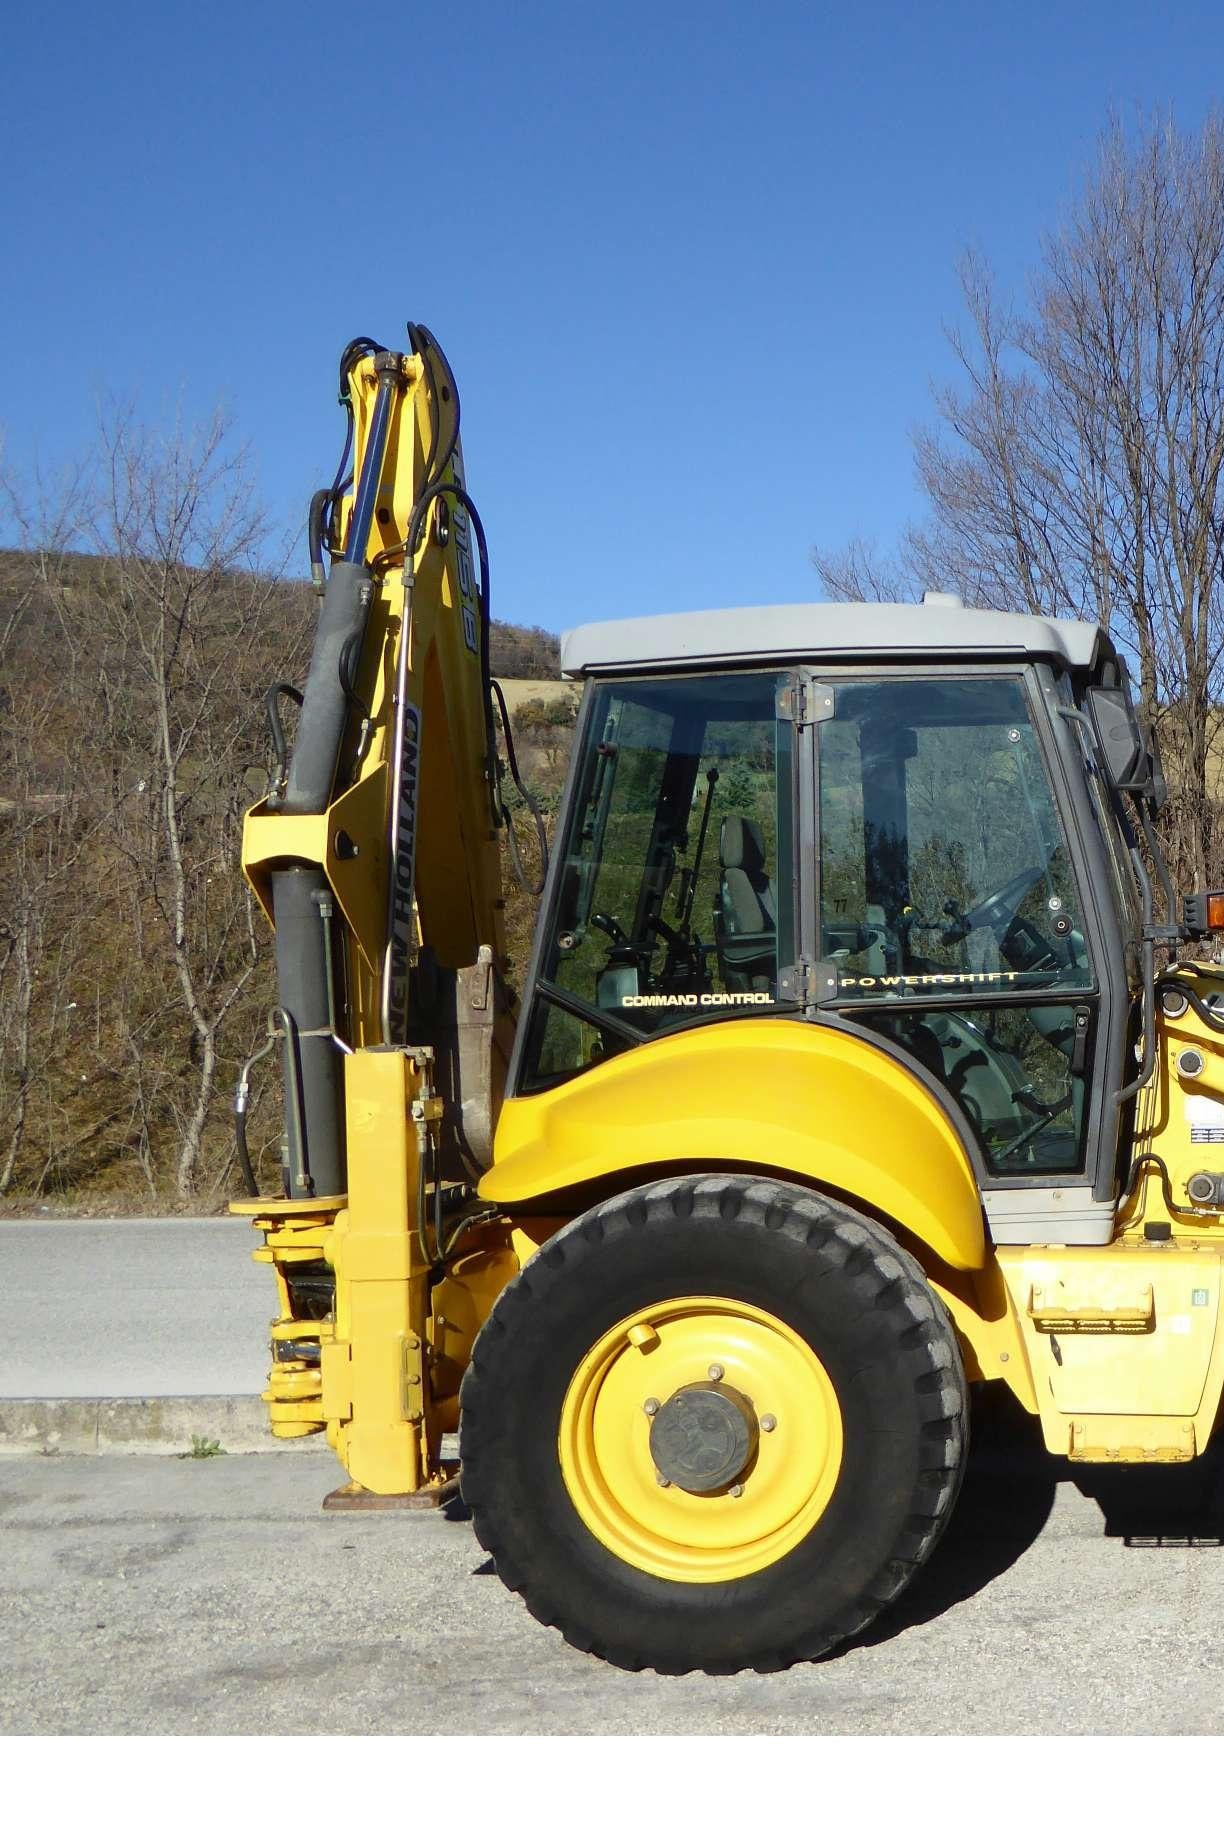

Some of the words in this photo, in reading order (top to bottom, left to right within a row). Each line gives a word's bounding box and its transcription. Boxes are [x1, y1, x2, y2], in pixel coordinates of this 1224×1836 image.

[393, 708, 419, 925] HOLLAND
[389, 932, 409, 1046] NEW
[622, 994, 697, 1007] COMMAND
[700, 993, 775, 1005] CONTROL
[841, 971, 1019, 987] POWERSHIFT
